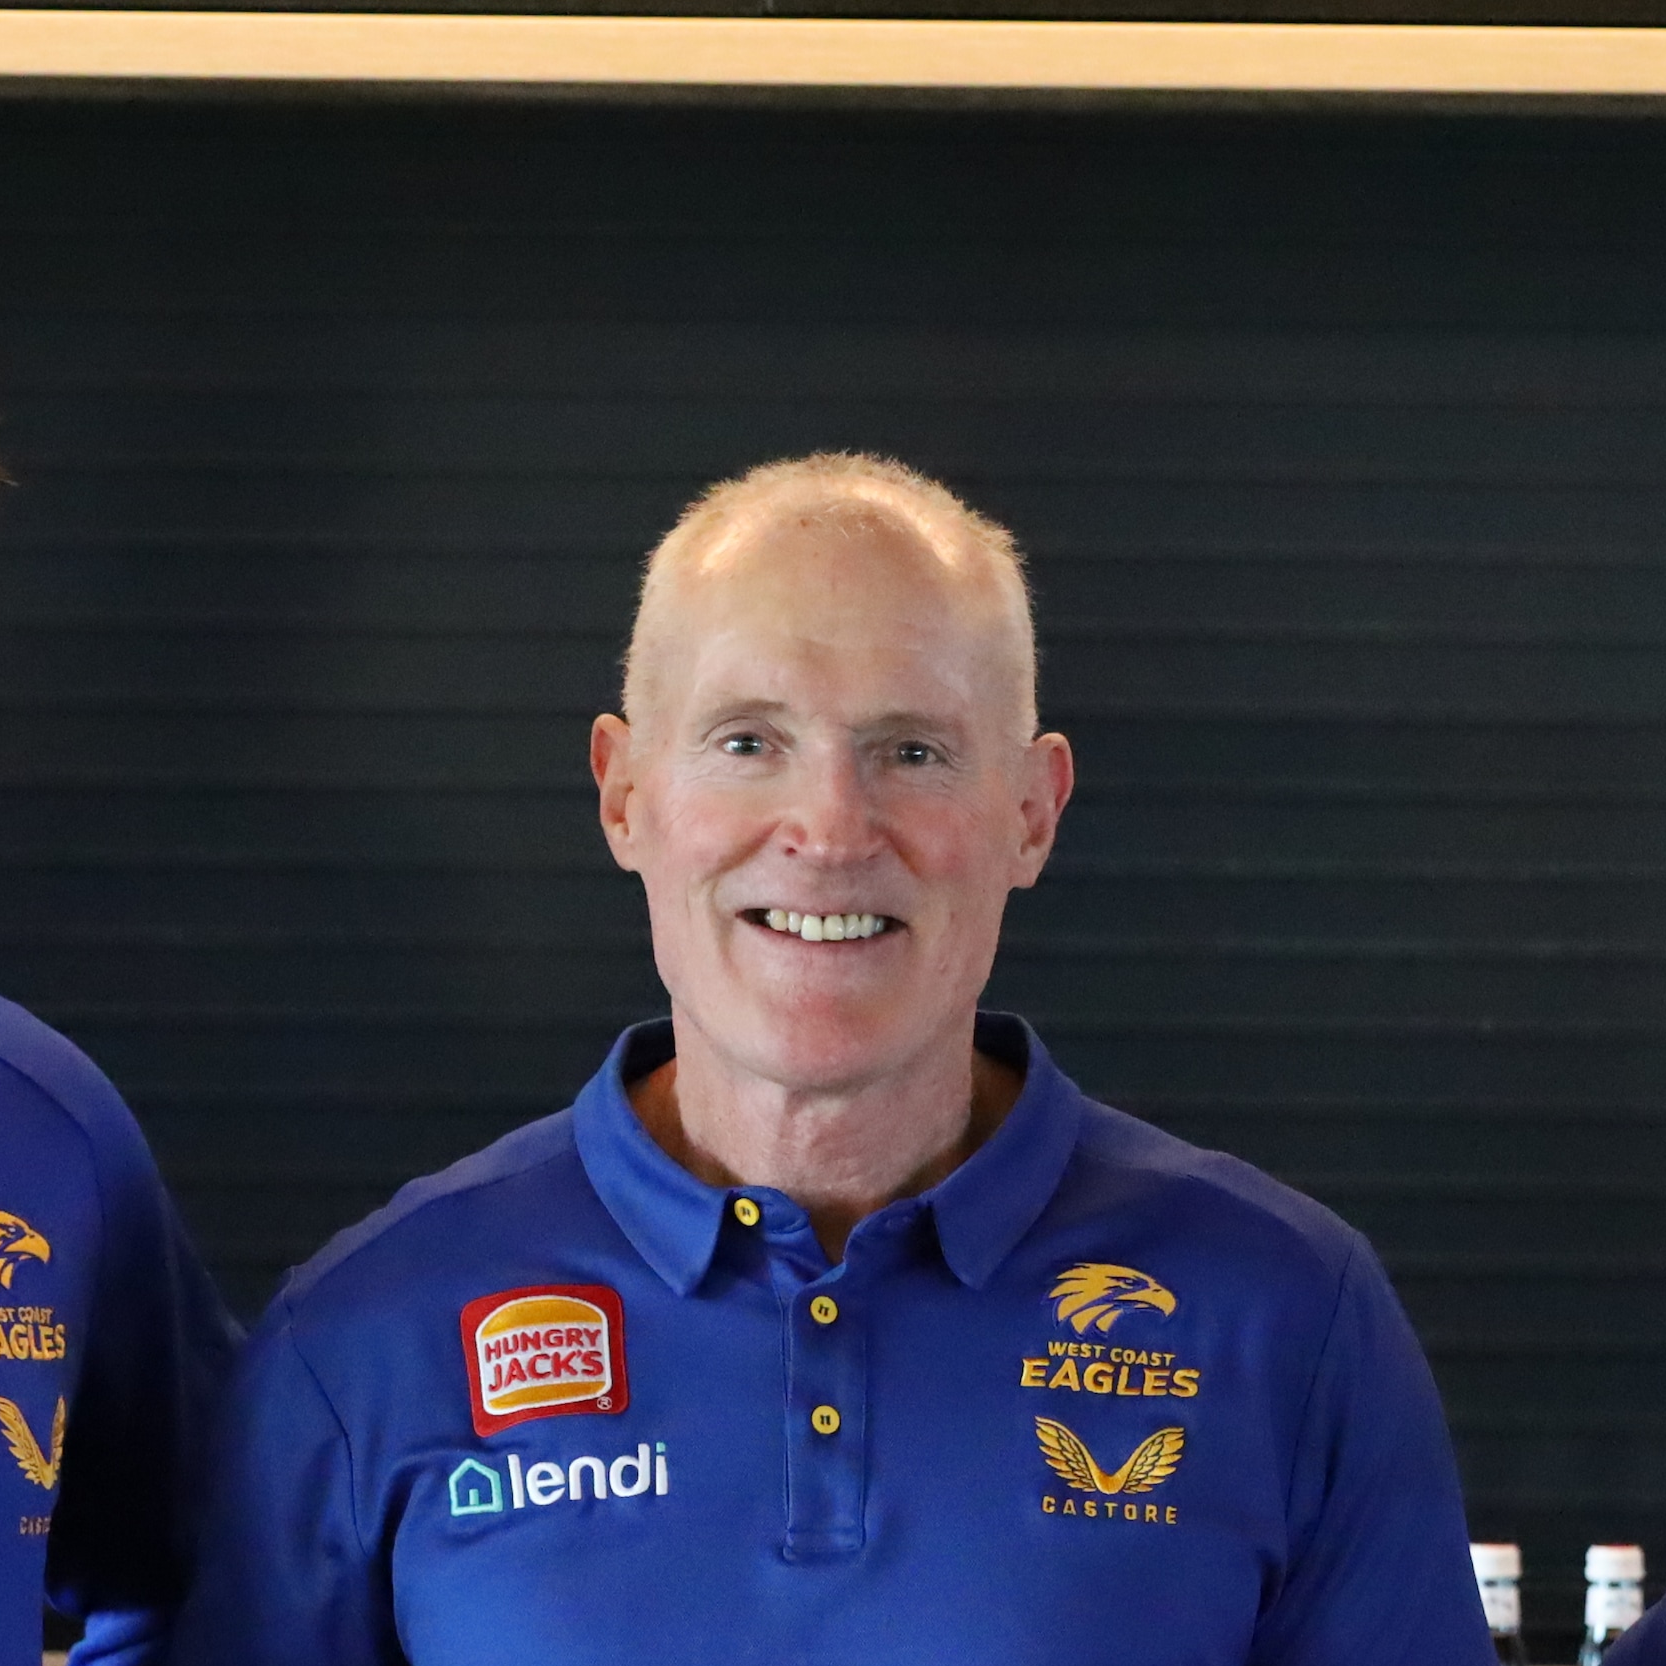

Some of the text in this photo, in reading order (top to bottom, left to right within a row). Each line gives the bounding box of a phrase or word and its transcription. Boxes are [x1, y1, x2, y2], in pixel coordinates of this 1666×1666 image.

[485, 1328, 601, 1362] HUNGRY
[1048, 1341, 1176, 1366] WEST COAST
[488, 1349, 604, 1392] JACK'S
[1020, 1358, 1200, 1397] EAGLES
[507, 1442, 668, 1509] lendi
[1042, 1495, 1177, 1525] CASTORE
